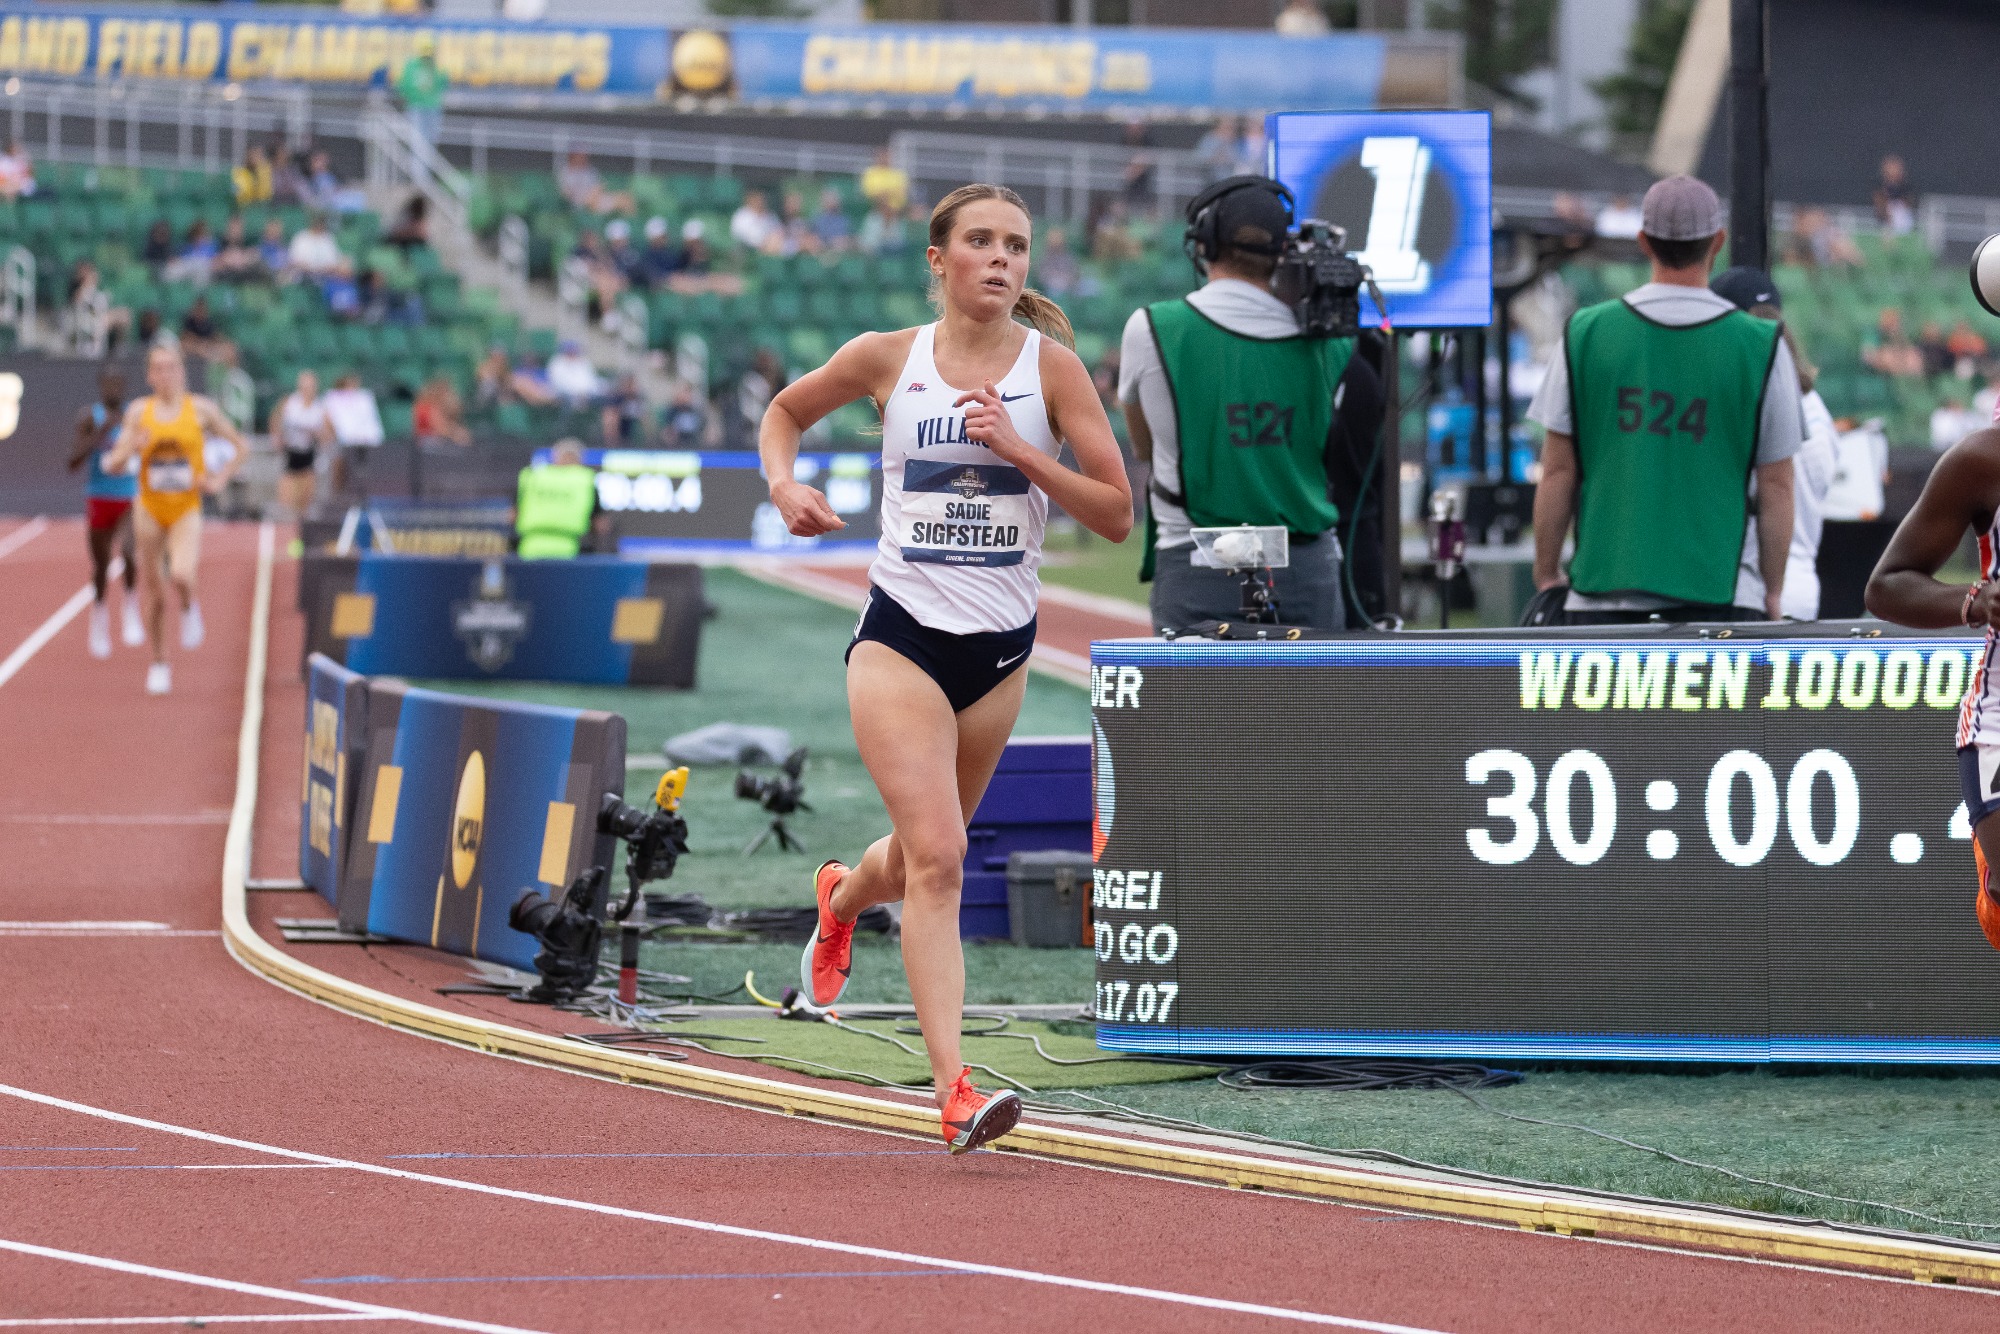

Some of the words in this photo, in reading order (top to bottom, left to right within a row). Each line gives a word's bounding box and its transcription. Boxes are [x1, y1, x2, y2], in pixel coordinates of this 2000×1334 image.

[98, 19, 221, 80] FIELD
[1346, 136, 1431, 294] 1
[917, 416, 990, 449] VILLA
[1226, 401, 1296, 448] 521
[1617, 387, 1708, 445] 524
[912, 521, 1019, 547] SIGFSTEAD
[945, 502, 991, 521] SADIE
[1519, 651, 1750, 710] WOMEN
[1119, 923, 1179, 964] GO
